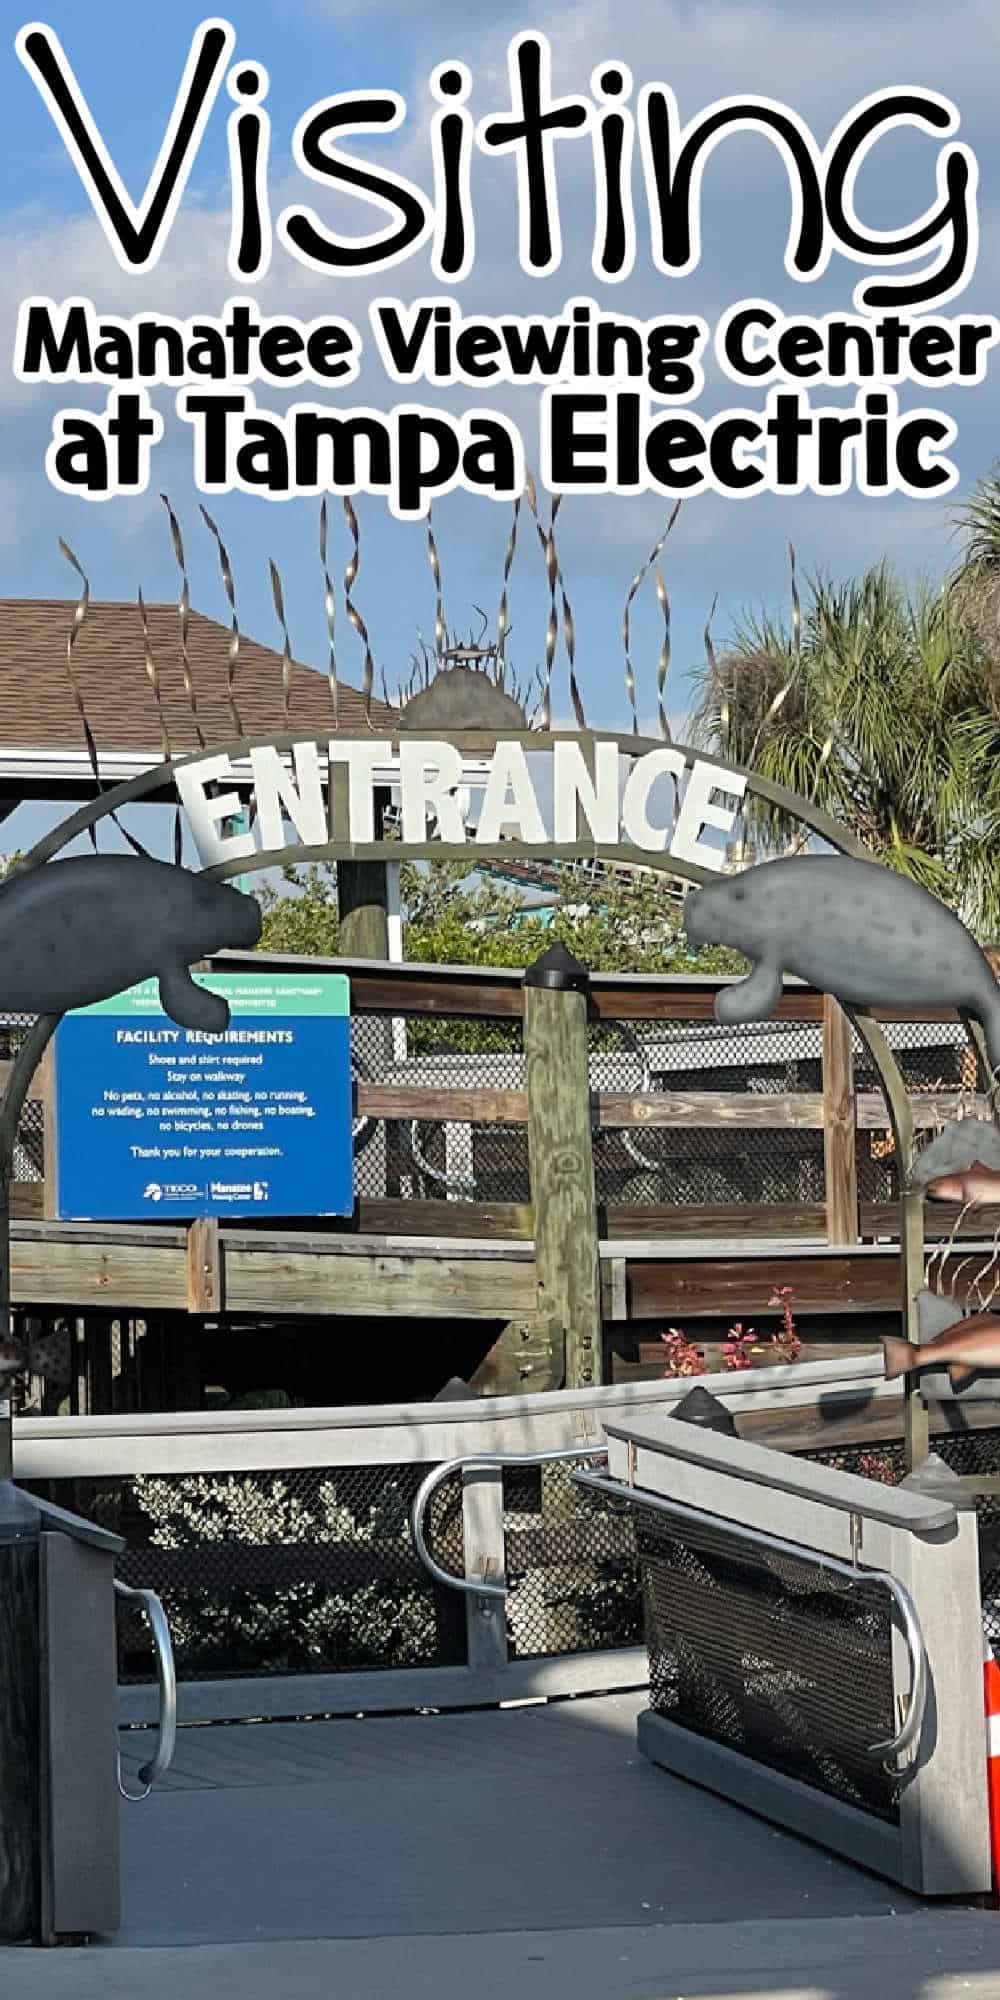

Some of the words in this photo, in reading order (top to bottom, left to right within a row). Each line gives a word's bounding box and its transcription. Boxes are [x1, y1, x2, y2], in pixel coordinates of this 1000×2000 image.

[174, 740, 747, 871] ENTRANCE
[117, 1030, 179, 1043] FACILITY
[185, 1029, 294, 1045] REQUIREMENTS
[149, 1053, 176, 1065] Shoes
[178, 1054, 197, 1065] and
[198, 1054, 220, 1065] shirt
[222, 1053, 263, 1067] required
[167, 1070, 188, 1084] Stay
[190, 1073, 202, 1081] on
[204, 1070, 245, 1084] walkway
[104, 1090, 120, 1101] No
[121, 1091, 145, 1103] pets,
[147, 1092, 160, 1101] no
[162, 1090, 200, 1102] alcohol,
[202, 1092, 215, 1101] no
[217, 1090, 253, 1103] skating,
[254, 1092, 268, 1101] no
[270, 1091, 307, 1103] running,
[92, 1107, 105, 1116] no
[107, 1106, 144, 1119] wading,
[147, 1107, 160, 1116] no
[162, 1106, 212, 1119] swimming,
[215, 1107, 228, 1116] no
[229, 1105, 262, 1118] fishing,
[264, 1107, 277, 1116] no
[278, 1104, 316, 1117] boating,
[159, 1122, 172, 1130] no
[174, 1120, 214, 1133] bicycles,
[217, 1122, 229, 1130] no
[231, 1120, 264, 1130] drones
[130, 1146, 160, 1158] Thank
[162, 1148, 181, 1160] you
[183, 1146, 198, 1158] for
[199, 1148, 221, 1160] your
[223, 1146, 284, 1159] cooperation.
[211, 1182, 252, 1193] Manatee
